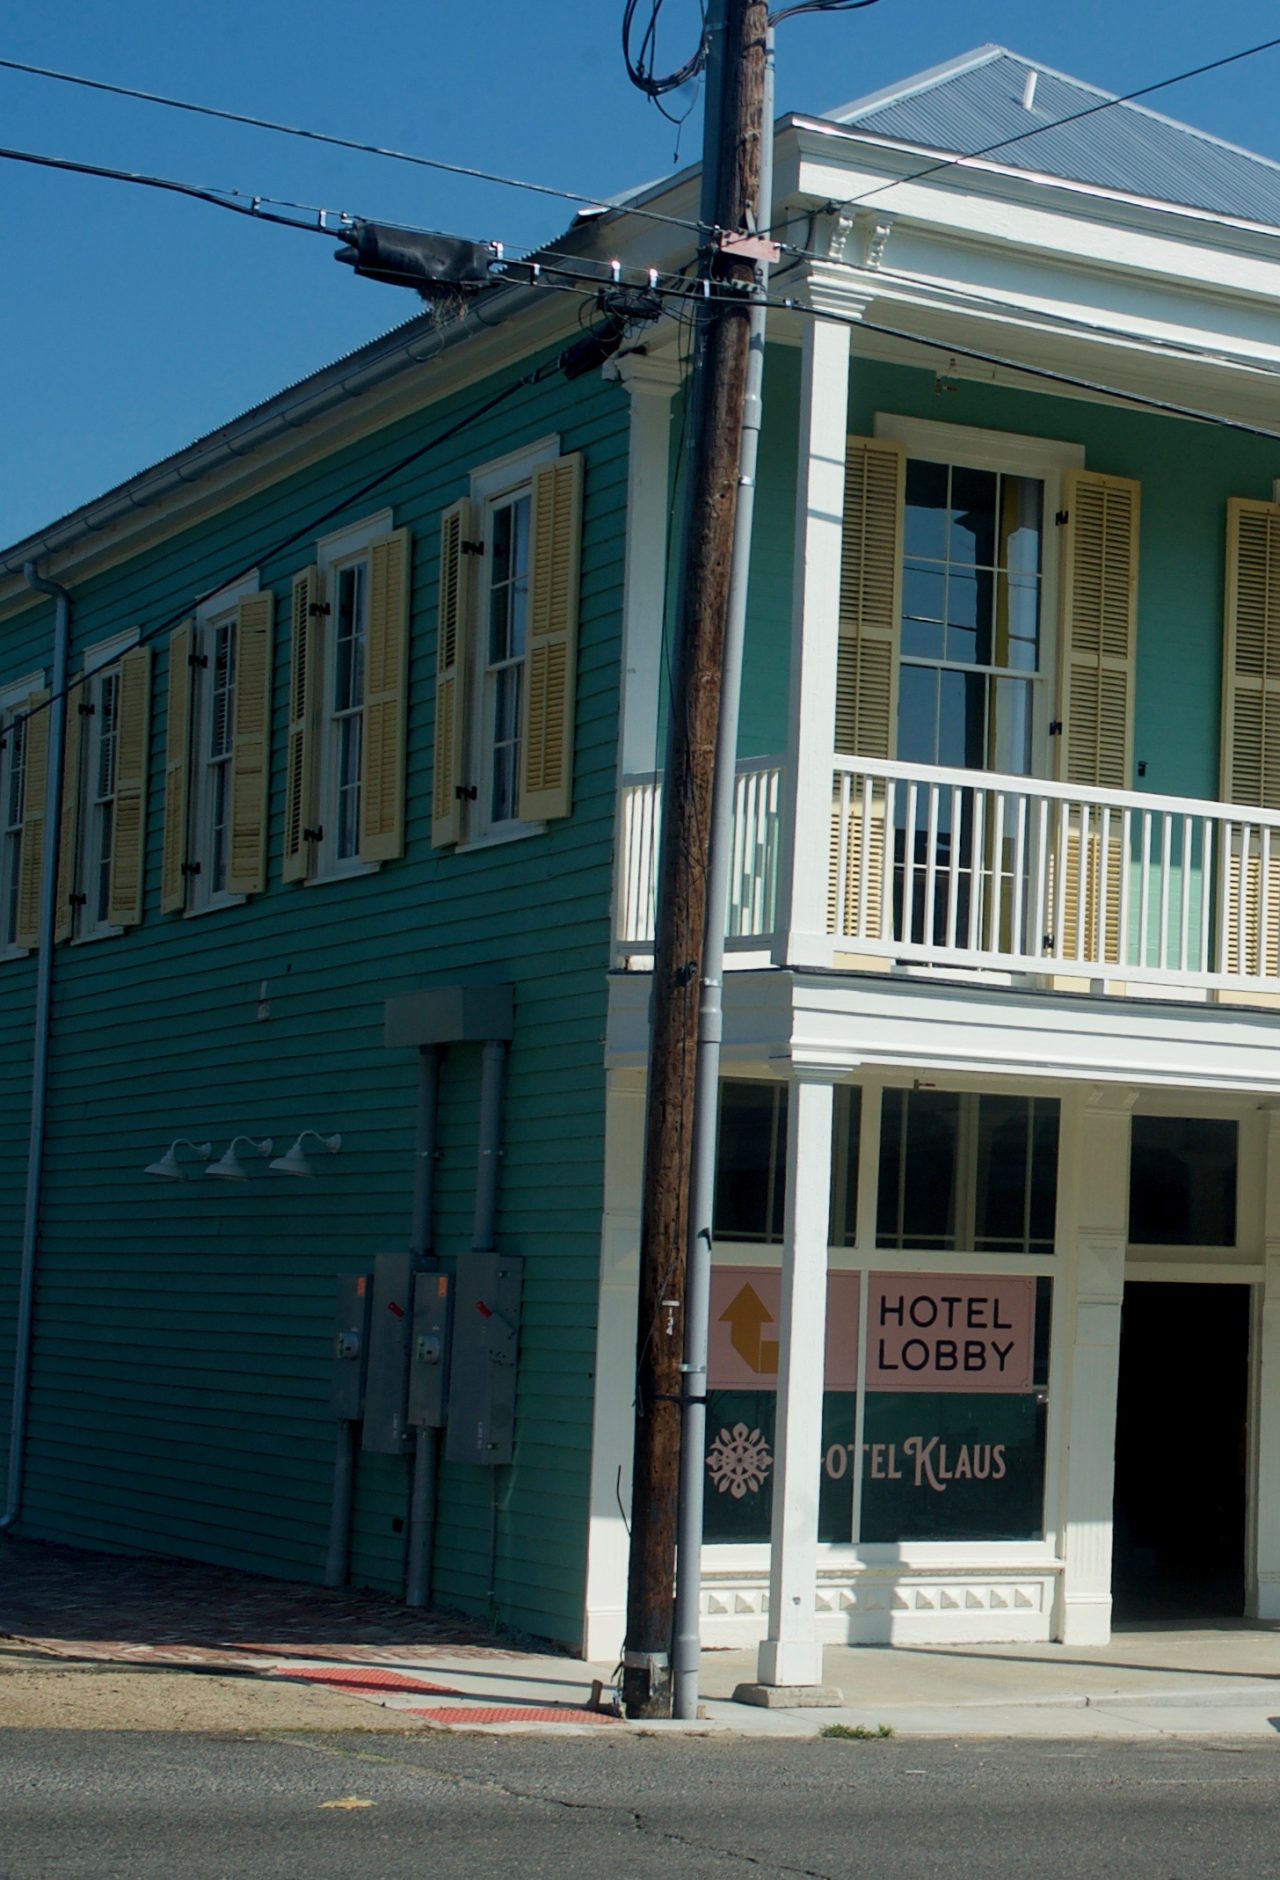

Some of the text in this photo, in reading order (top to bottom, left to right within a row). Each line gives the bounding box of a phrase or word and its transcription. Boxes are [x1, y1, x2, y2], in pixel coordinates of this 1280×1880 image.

[880, 1295, 1012, 1329] HOTEL
[879, 1338, 1015, 1372] LOBBY
[820, 1436, 1006, 1492] OEL KLAUS
